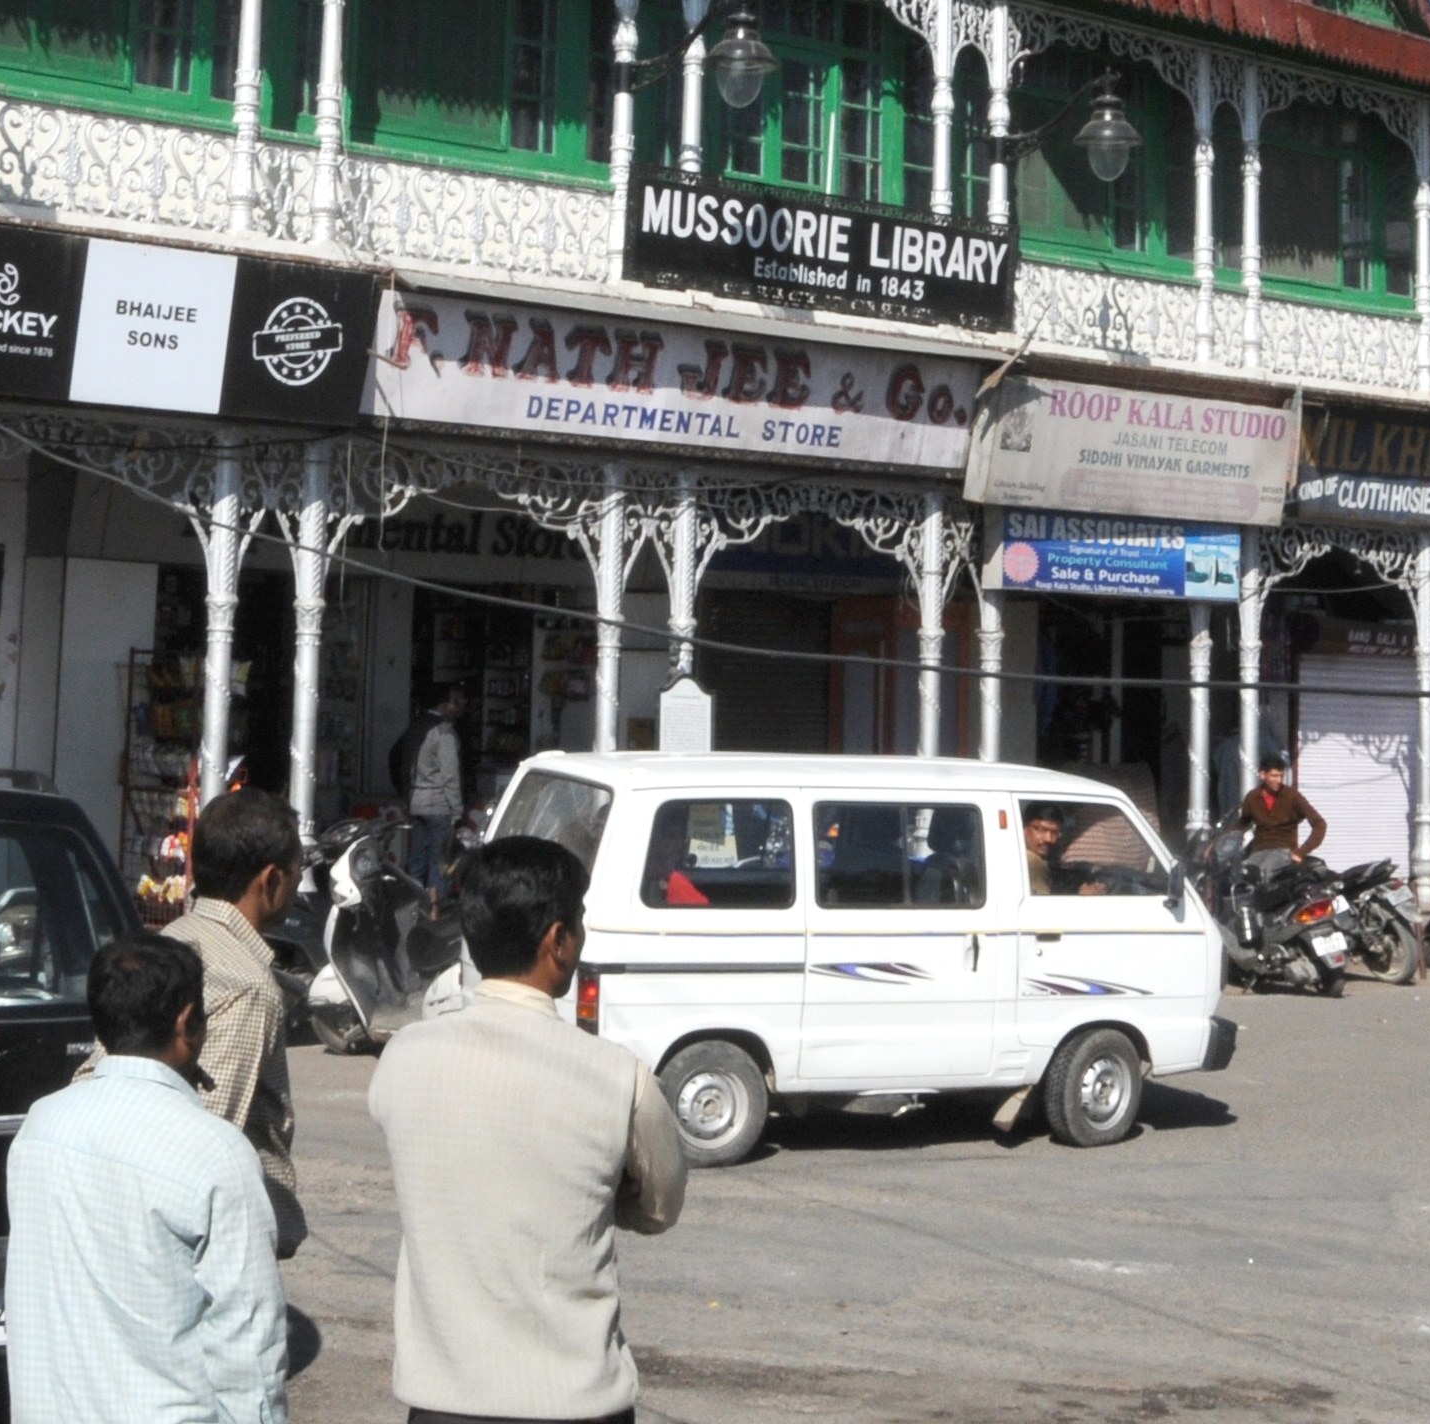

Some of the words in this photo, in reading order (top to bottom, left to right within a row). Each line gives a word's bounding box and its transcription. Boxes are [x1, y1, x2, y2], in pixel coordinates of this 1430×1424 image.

[641, 185, 852, 263] MUSSOORIE
[869, 222, 1009, 286] LIBRARY
[753, 256, 848, 291] Established
[855, 273, 872, 293] in
[879, 277, 925, 302] 1843
[115, 298, 198, 325] BHAIJEE
[126, 329, 180, 351] SONS
[274, 330, 322, 343] PREFERRED
[284, 341, 312, 352] STORE
[8, 343, 32, 355] since
[33, 346, 54, 358] 1876
[459, 307, 665, 395] NATH
[677, 339, 811, 411] JEE
[830, 371, 864, 414] &
[525, 394, 740, 440] DEPARTMENTAL
[761, 419, 842, 449] STORE
[1048, 388, 1122, 423] ROOP
[1125, 398, 1194, 432] KALA
[1200, 408, 1288, 442] STUDIO
[1113, 431, 1165, 451] JASANI
[1166, 435, 1229, 457] TELECOM
[1078, 449, 1123, 468] SIDDHI
[1126, 453, 1183, 473] VINAYAK
[1185, 459, 1251, 479] GARMENTS
[1324, 476, 1339, 496] OF
[1337, 480, 1390, 511] CLOTH
[1008, 513, 1047, 541] SAI
[1051, 515, 1186, 550] ASSOCIATES
[1047, 552, 1101, 569] Property
[1104, 556, 1169, 571] Consultant
[1068, 544, 1108, 557] Signature
[1108, 547, 1119, 556] of
[1119, 548, 1140, 558] Trust
[1051, 566, 1082, 581] Sale
[1084, 568, 1095, 581] &
[1098, 568, 1161, 585] Purchase
